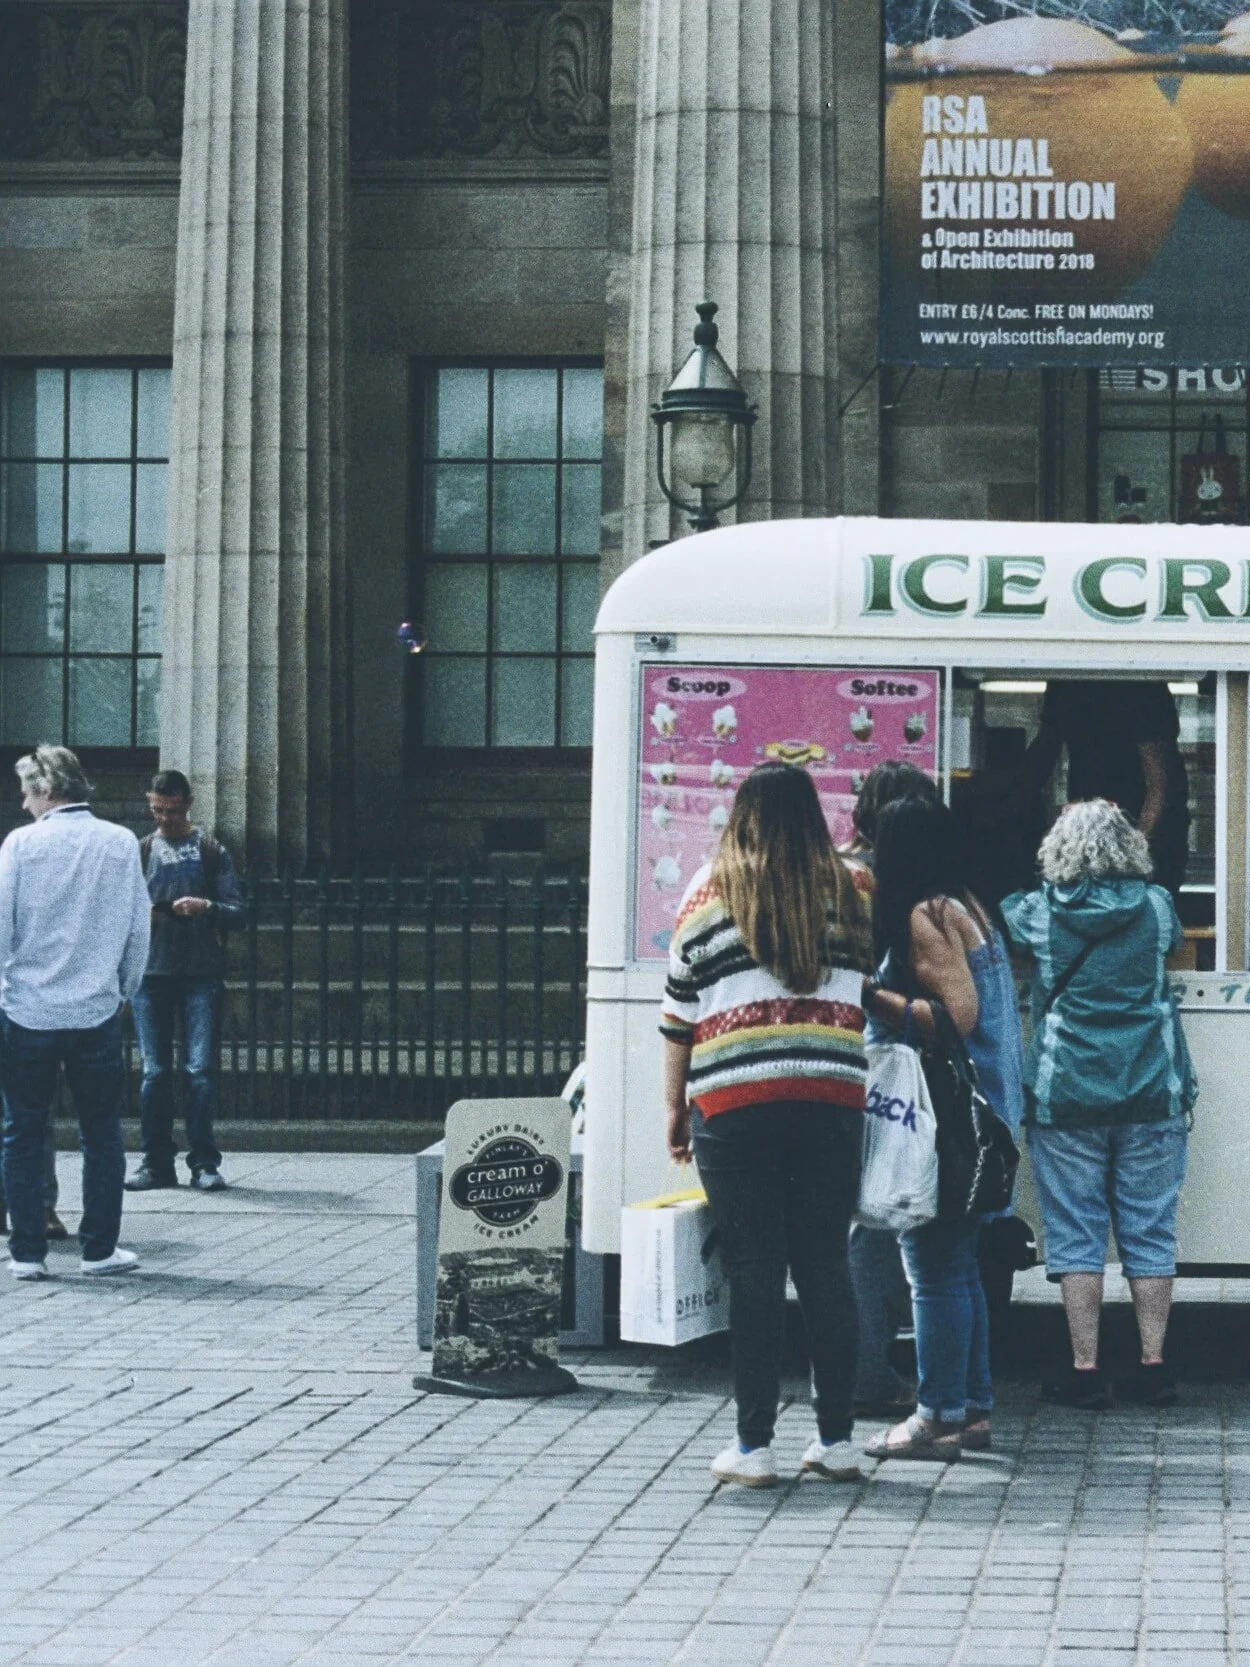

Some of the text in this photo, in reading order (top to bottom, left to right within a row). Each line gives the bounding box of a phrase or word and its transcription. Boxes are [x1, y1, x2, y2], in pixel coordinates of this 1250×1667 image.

[922, 94, 988, 134] RSA
[920, 138, 1053, 177] ANNUAL
[920, 180, 1116, 220] EXHIBITION
[921, 227, 1074, 248] & Open Exhibition
[921, 249, 1095, 270] of Architecture 2018
[919, 303, 957, 320] ENTRY
[997, 304, 1031, 320] Conc.
[1035, 304, 1064, 320] FREE
[1068, 304, 1086, 320] ON
[1089, 304, 1154, 320] MONDAYS!
[920, 326, 1166, 349] www.royalscottishacademy.org
[858, 553, 1048, 620] ICE
[666, 676, 732, 698] Scoop
[850, 678, 919, 698] Softee
[466, 1165, 527, 1184] cream
[466, 1181, 544, 1203] GALLOWAY
[473, 1222, 494, 1239] ICE
